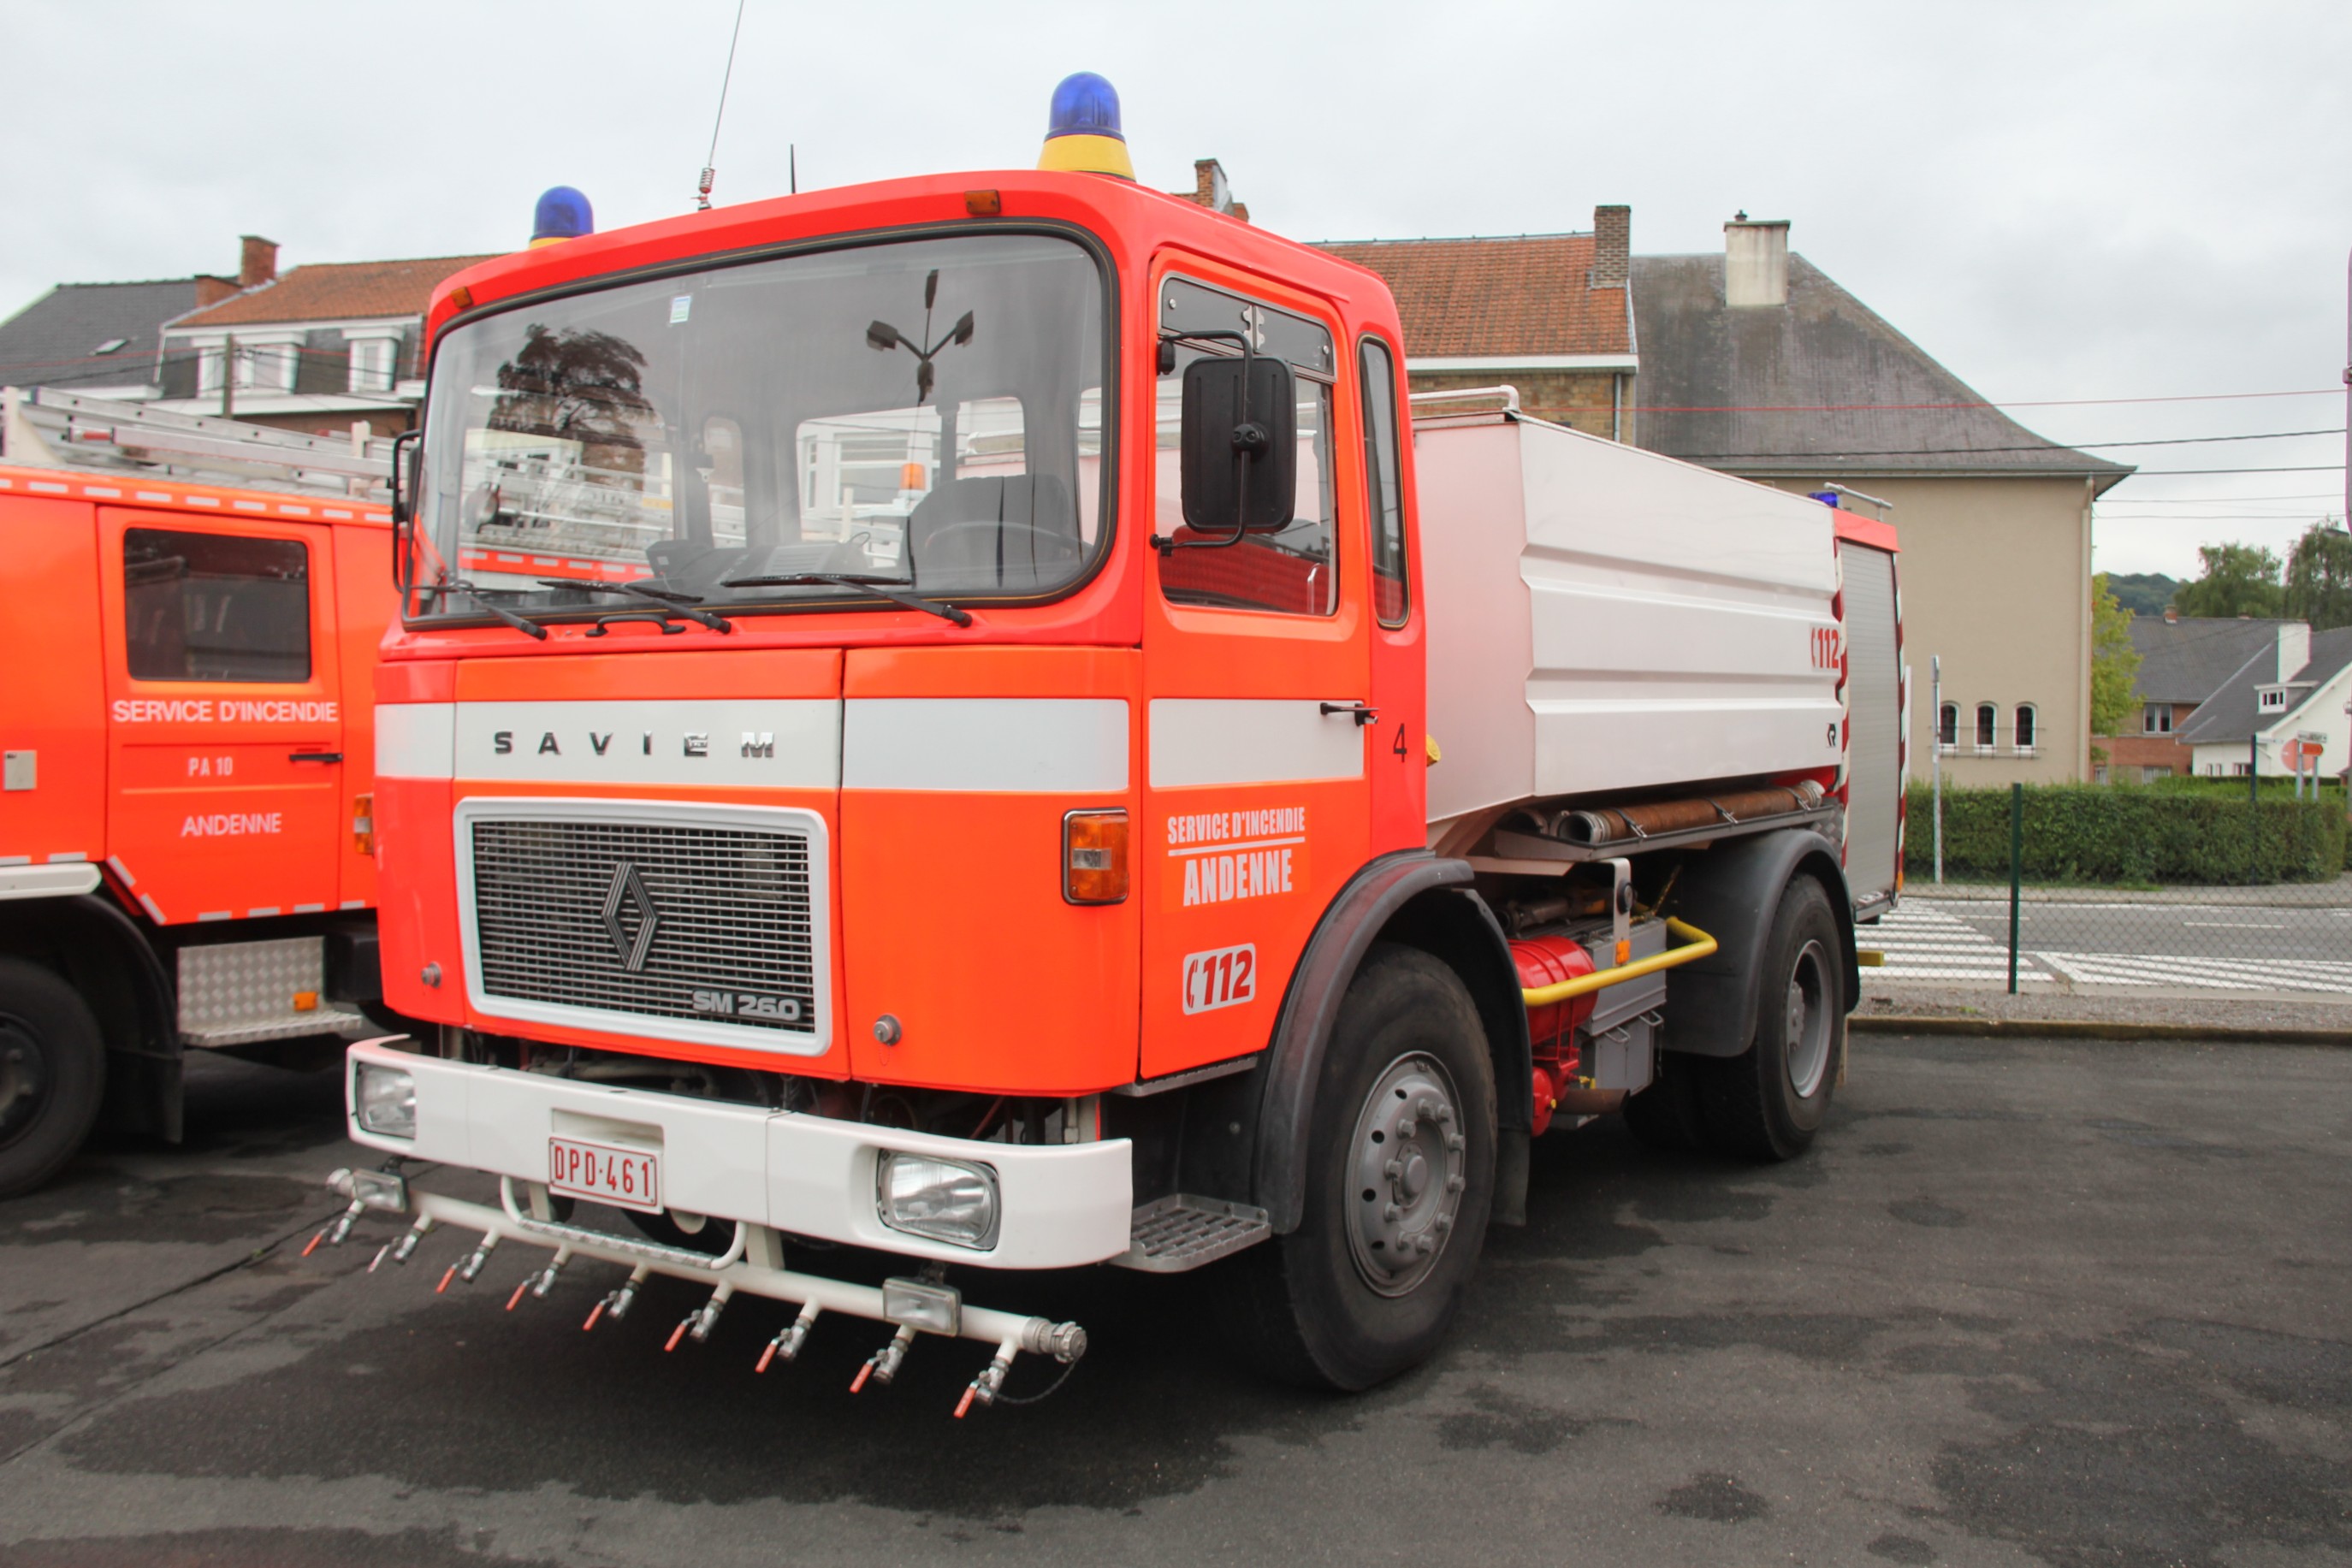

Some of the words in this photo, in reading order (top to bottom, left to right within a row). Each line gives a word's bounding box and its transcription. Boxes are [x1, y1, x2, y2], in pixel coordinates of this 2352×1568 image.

[1818, 628, 1839, 668] 112
[113, 701, 212, 722] SERVICE
[220, 701, 339, 722] D'INCENDIE
[494, 731, 774, 757] SAVIEM
[1393, 723, 1407, 762] 4
[188, 758, 210, 777] PA
[216, 757, 233, 776] 10
[181, 814, 282, 837] ANDENNE
[1168, 813, 1229, 844] SERVICE
[1232, 807, 1306, 838] D'INCENDIE
[1183, 849, 1292, 907] ANDENNE
[1203, 950, 1253, 1006] 112
[692, 990, 733, 1015] SM
[738, 995, 802, 1021] 260
